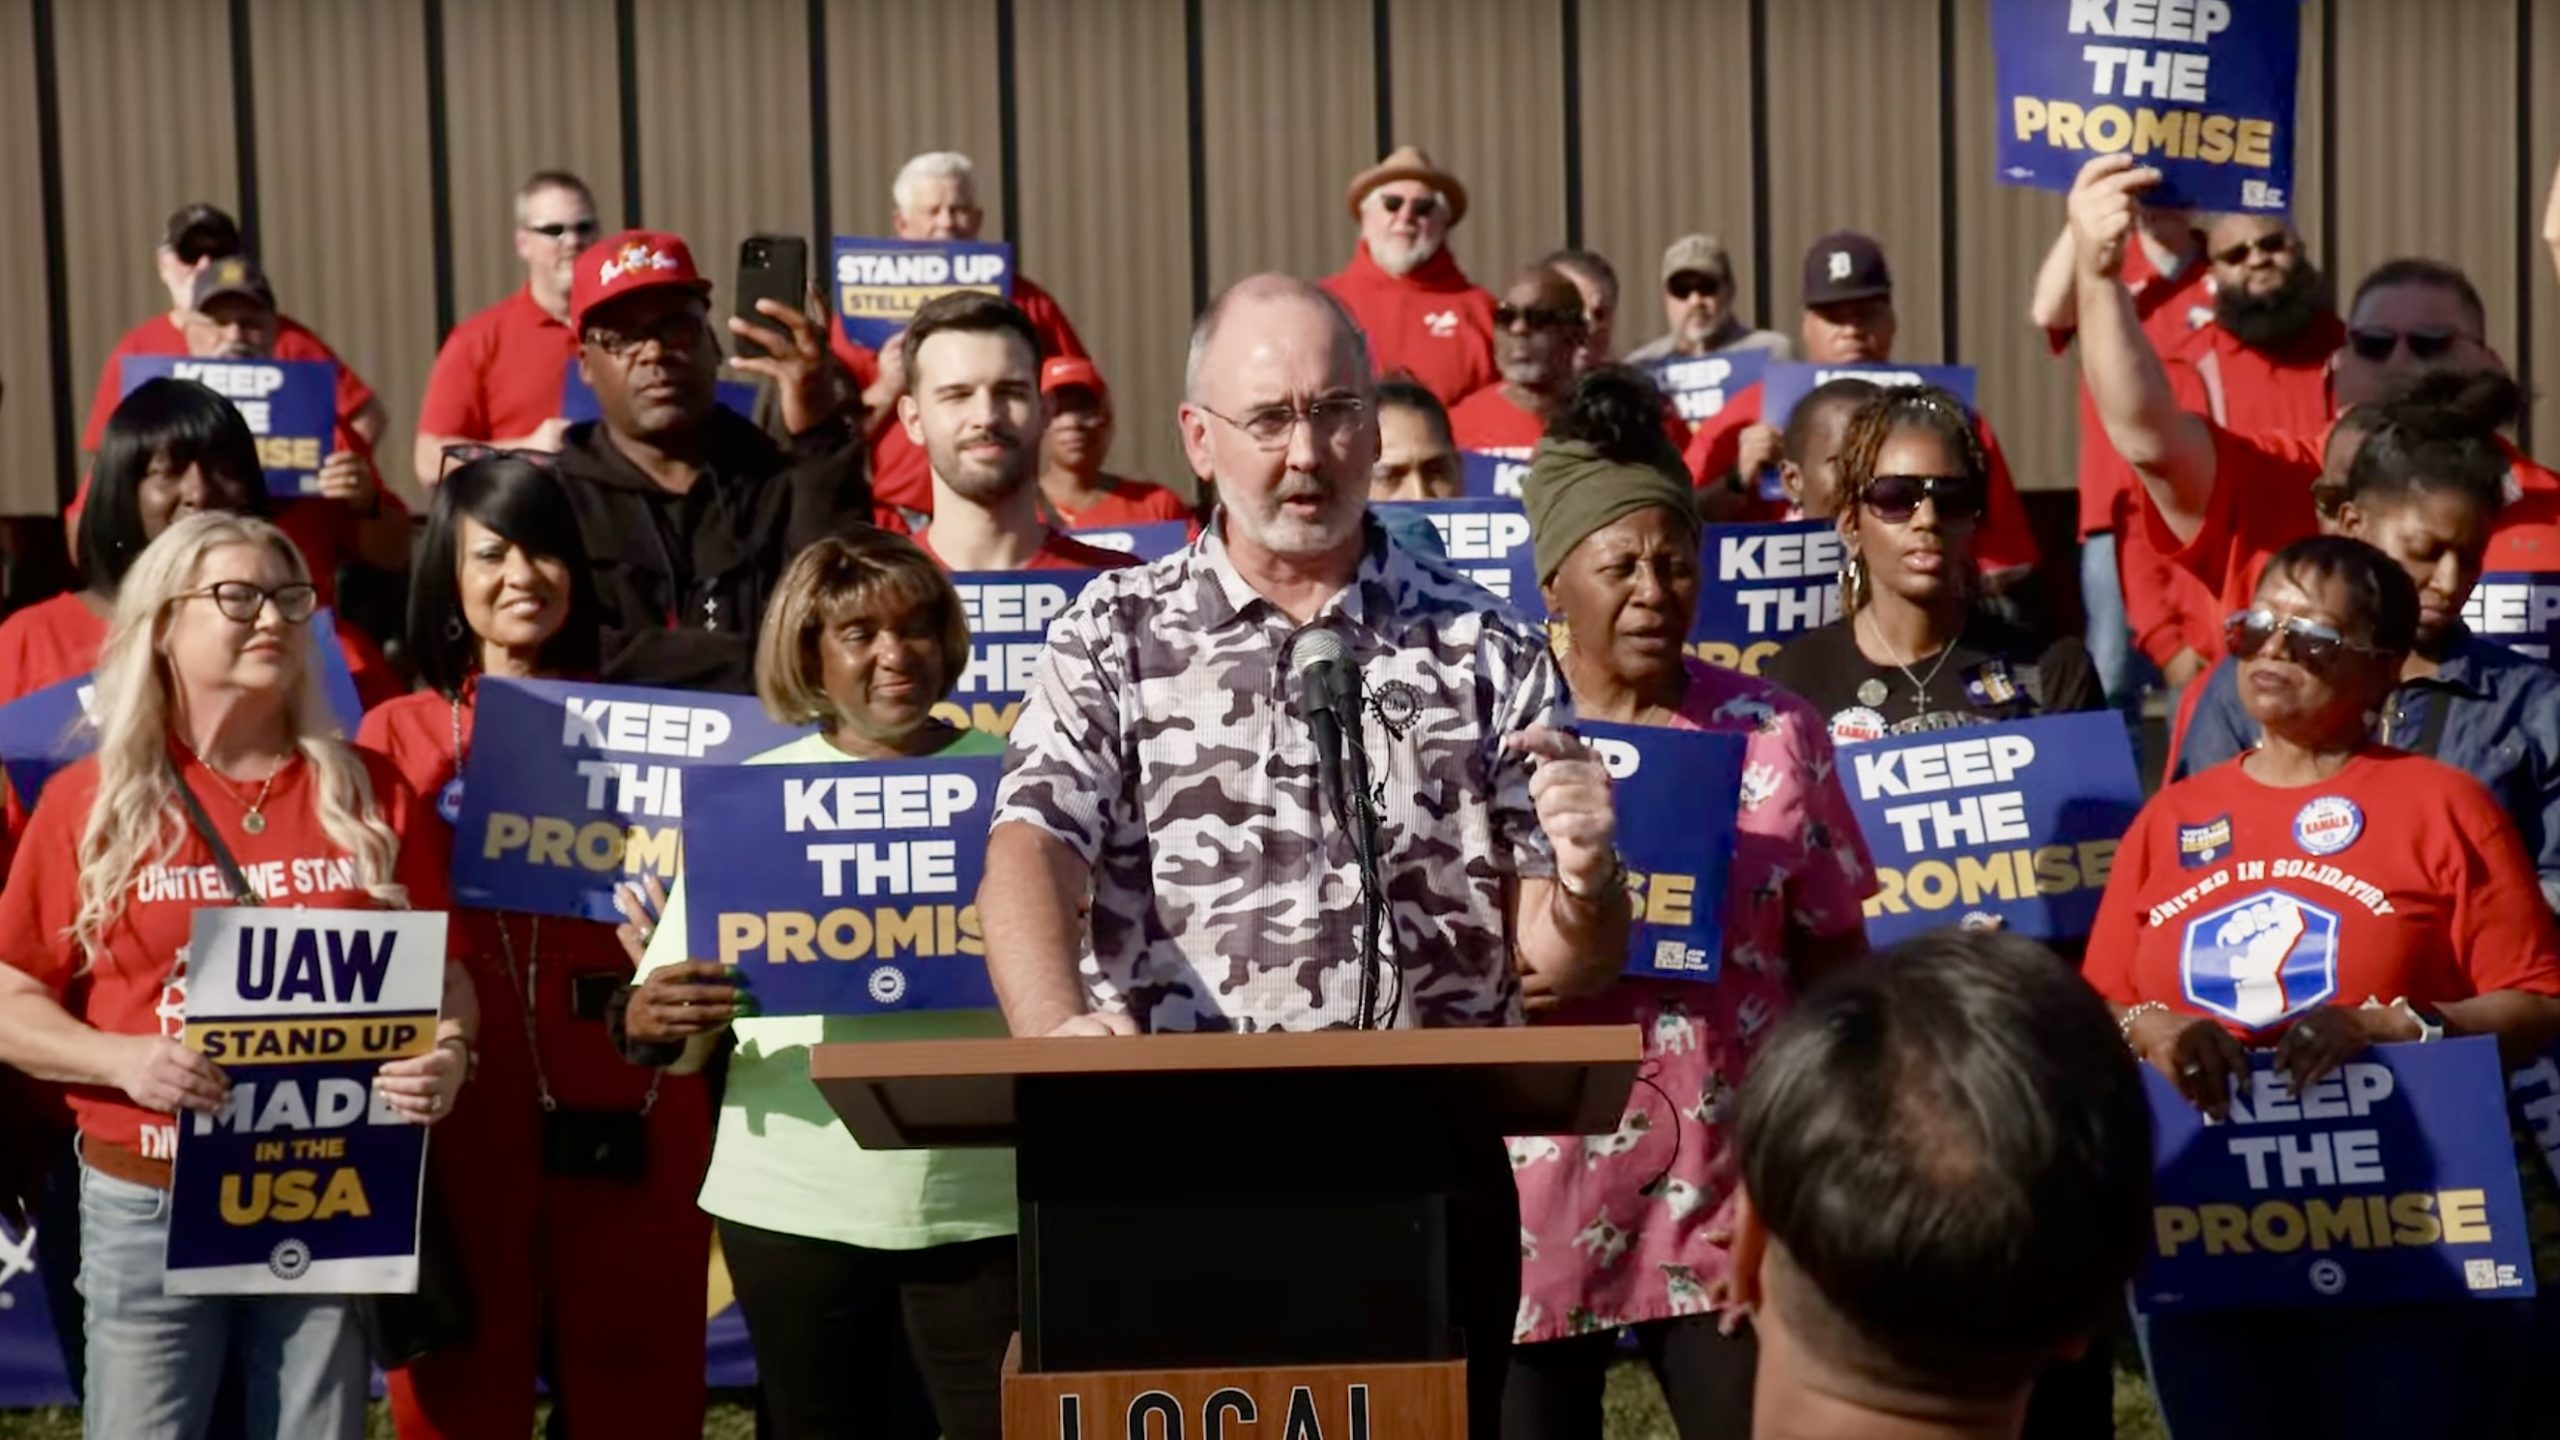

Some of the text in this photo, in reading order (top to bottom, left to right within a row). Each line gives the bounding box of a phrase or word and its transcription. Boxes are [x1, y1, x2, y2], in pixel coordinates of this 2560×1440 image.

[2068, 0, 2231, 44] KEEP
[2083, 45, 2210, 102] THE
[2013, 96, 2273, 167] PROMISE
[837, 254, 1005, 285] STAND UP
[1673, 387, 1725, 419] HE
[1427, 513, 1530, 559] EP
[1719, 531, 1844, 581] KEE
[957, 583, 1067, 634] EEP
[2460, 584, 2560, 633] EEP
[957, 643, 1046, 693] HE
[563, 698, 731, 757] KEEP
[1854, 735, 2036, 800] KEEP
[784, 773, 978, 832] KEEP
[1884, 791, 2030, 853] THE
[482, 811, 683, 877] PROM
[806, 840, 957, 896] THE
[247, 860, 289, 900] WE
[291, 857, 359, 894] STAN
[1861, 837, 2121, 918] ROMISE
[2149, 869, 2230, 928] UNITED
[2236, 860, 2265, 881] IN
[718, 904, 986, 964] PROMIS
[236, 927, 398, 1003] UAW
[202, 1024, 418, 1058] STAND UP
[254, 1137, 346, 1162] IN THE
[2228, 1129, 2385, 1189] THE
[219, 1167, 371, 1227] USA
[2153, 1189, 2492, 1257] PROMISE
